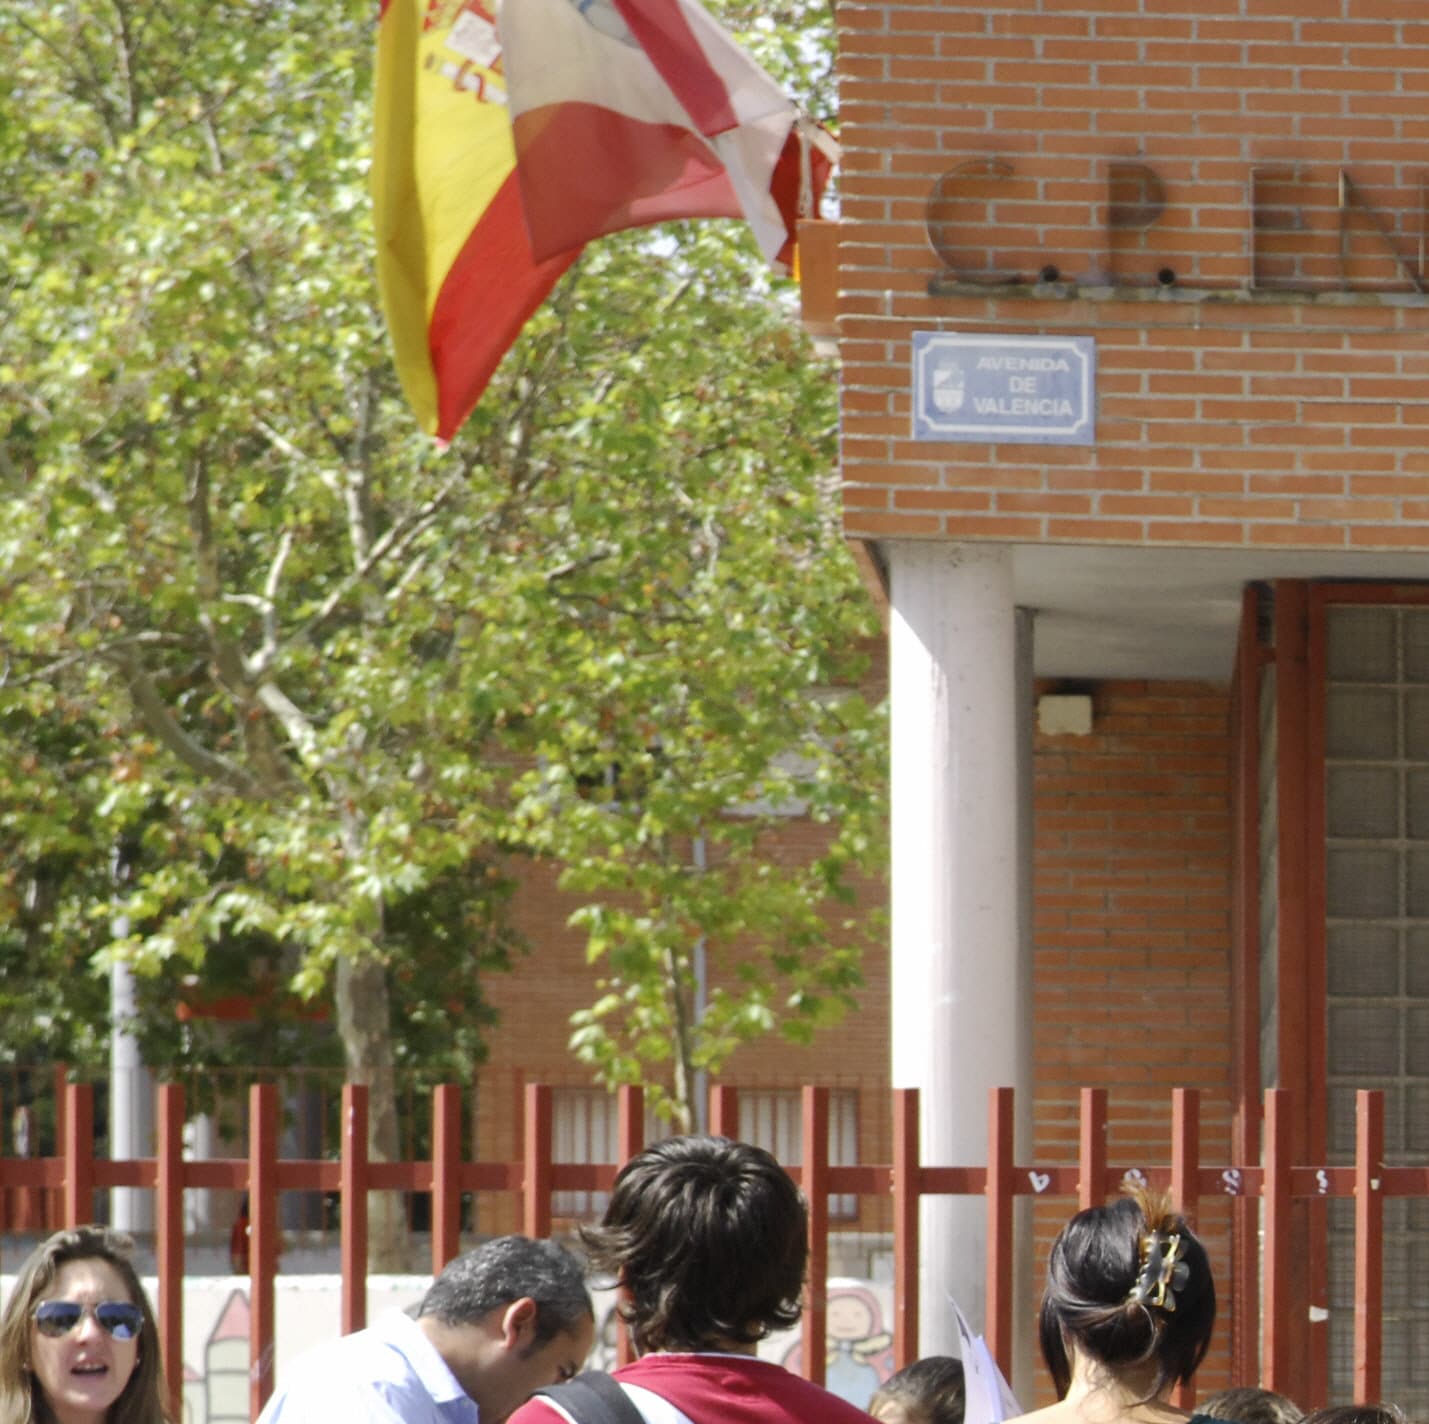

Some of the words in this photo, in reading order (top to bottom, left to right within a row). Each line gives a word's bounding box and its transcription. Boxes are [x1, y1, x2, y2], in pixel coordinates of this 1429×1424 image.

[976, 356, 1070, 372] AVENIDA
[1009, 376, 1037, 393] DE
[973, 397, 1073, 416] VALENCIA
